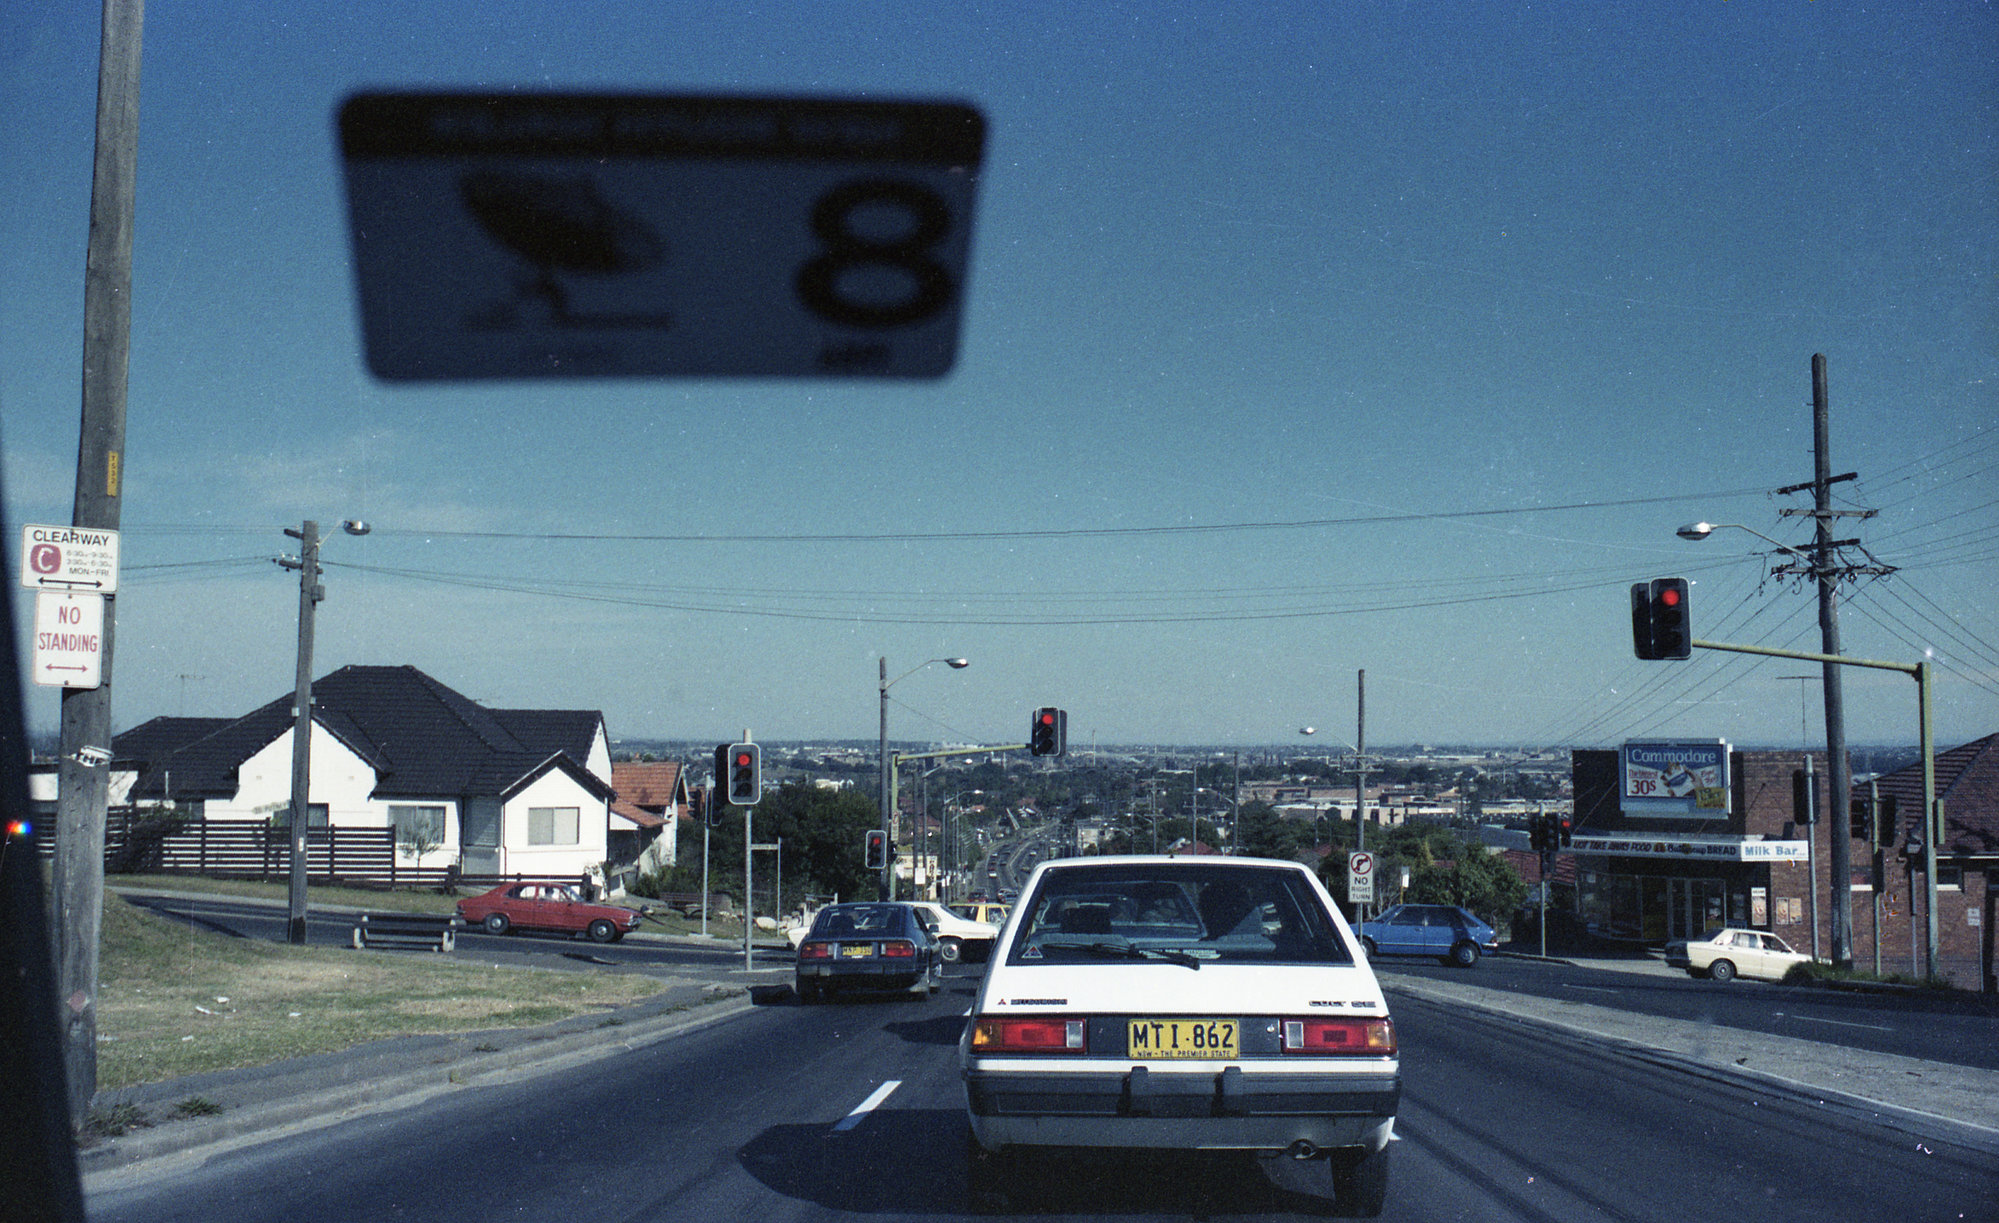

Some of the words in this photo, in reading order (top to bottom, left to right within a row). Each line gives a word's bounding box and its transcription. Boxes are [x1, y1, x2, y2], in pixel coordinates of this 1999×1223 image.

[33, 529, 109, 546] CLEARWAY
[58, 605, 81, 625] NO
[38, 632, 98, 653] STANDING
[1631, 749, 1717, 763] Commodore
[1707, 845, 1736, 856] BREAD
[1744, 846, 1770, 856] Milk
[1354, 876, 1368, 885] NO
[1177, 1050, 1208, 1058] PREMIER
[1210, 1050, 1231, 1058] STATE
